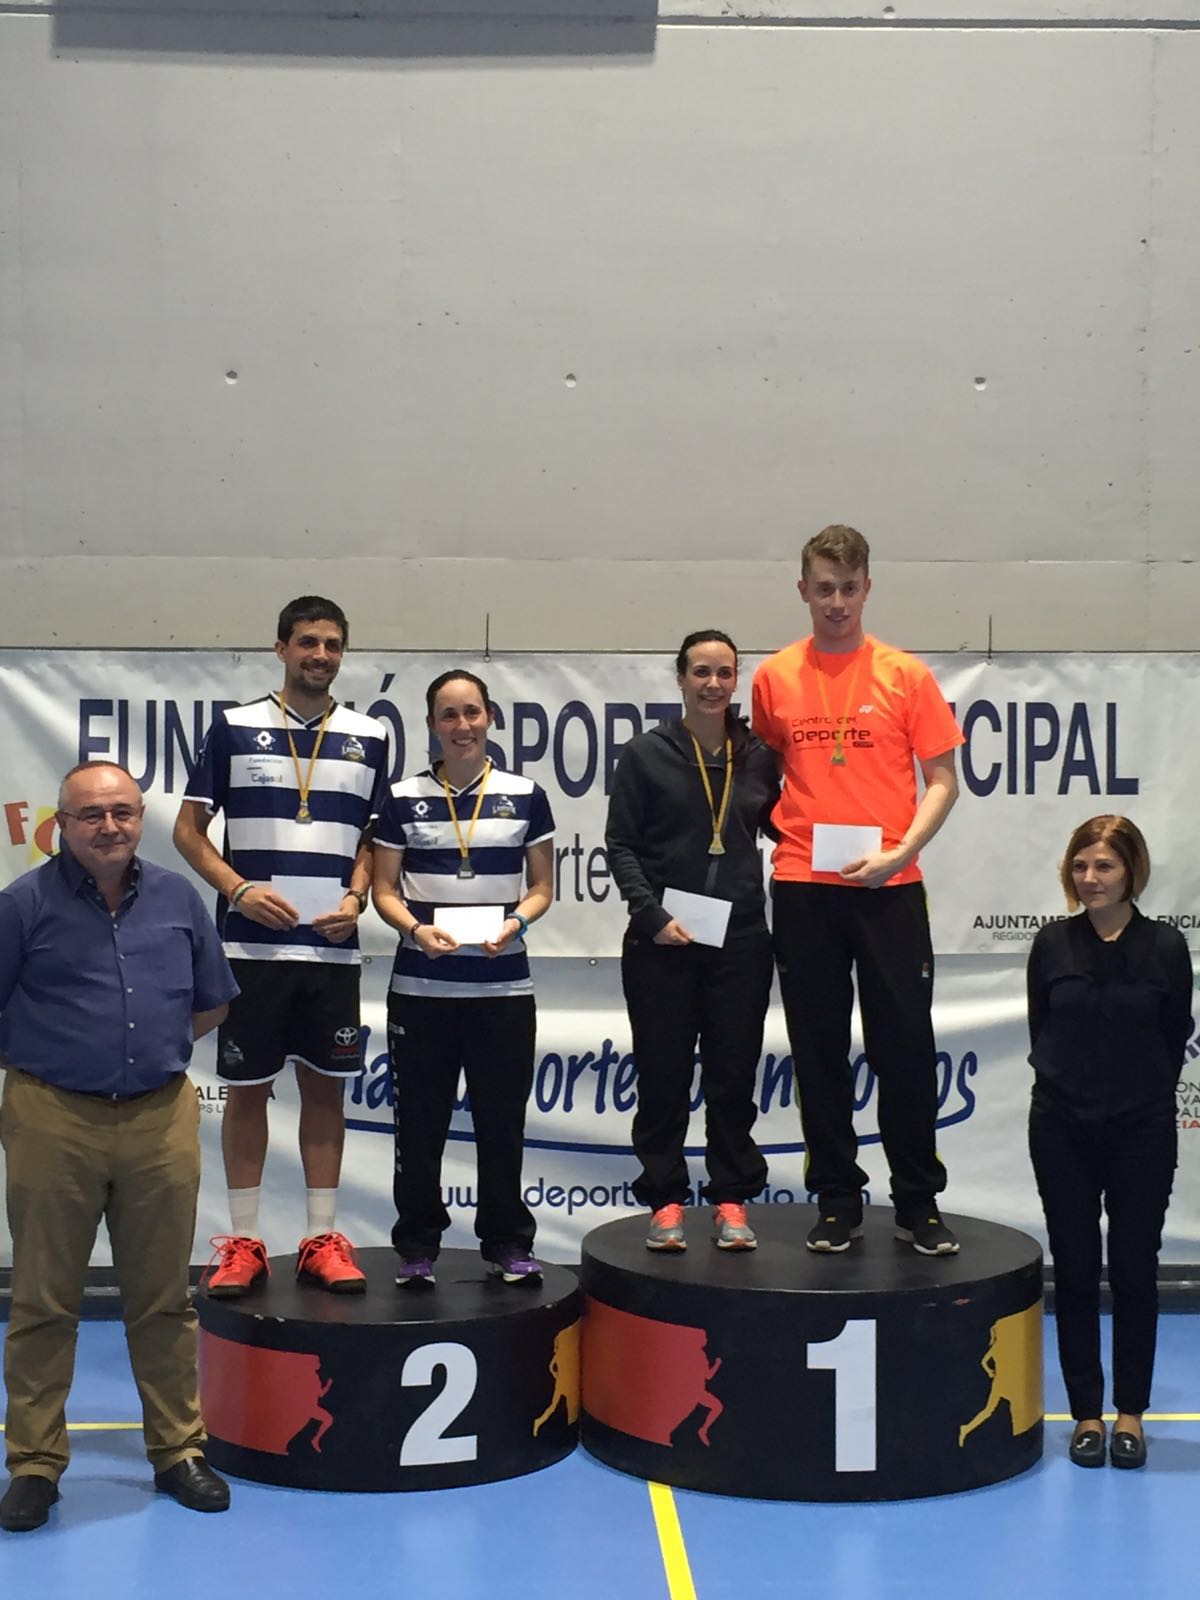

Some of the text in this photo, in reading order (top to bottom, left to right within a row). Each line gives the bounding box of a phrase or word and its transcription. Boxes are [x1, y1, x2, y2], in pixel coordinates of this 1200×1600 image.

[792, 727, 871, 743] Deporte
[400, 1342, 478, 1466] 2
[807, 1319, 876, 1472] 1
